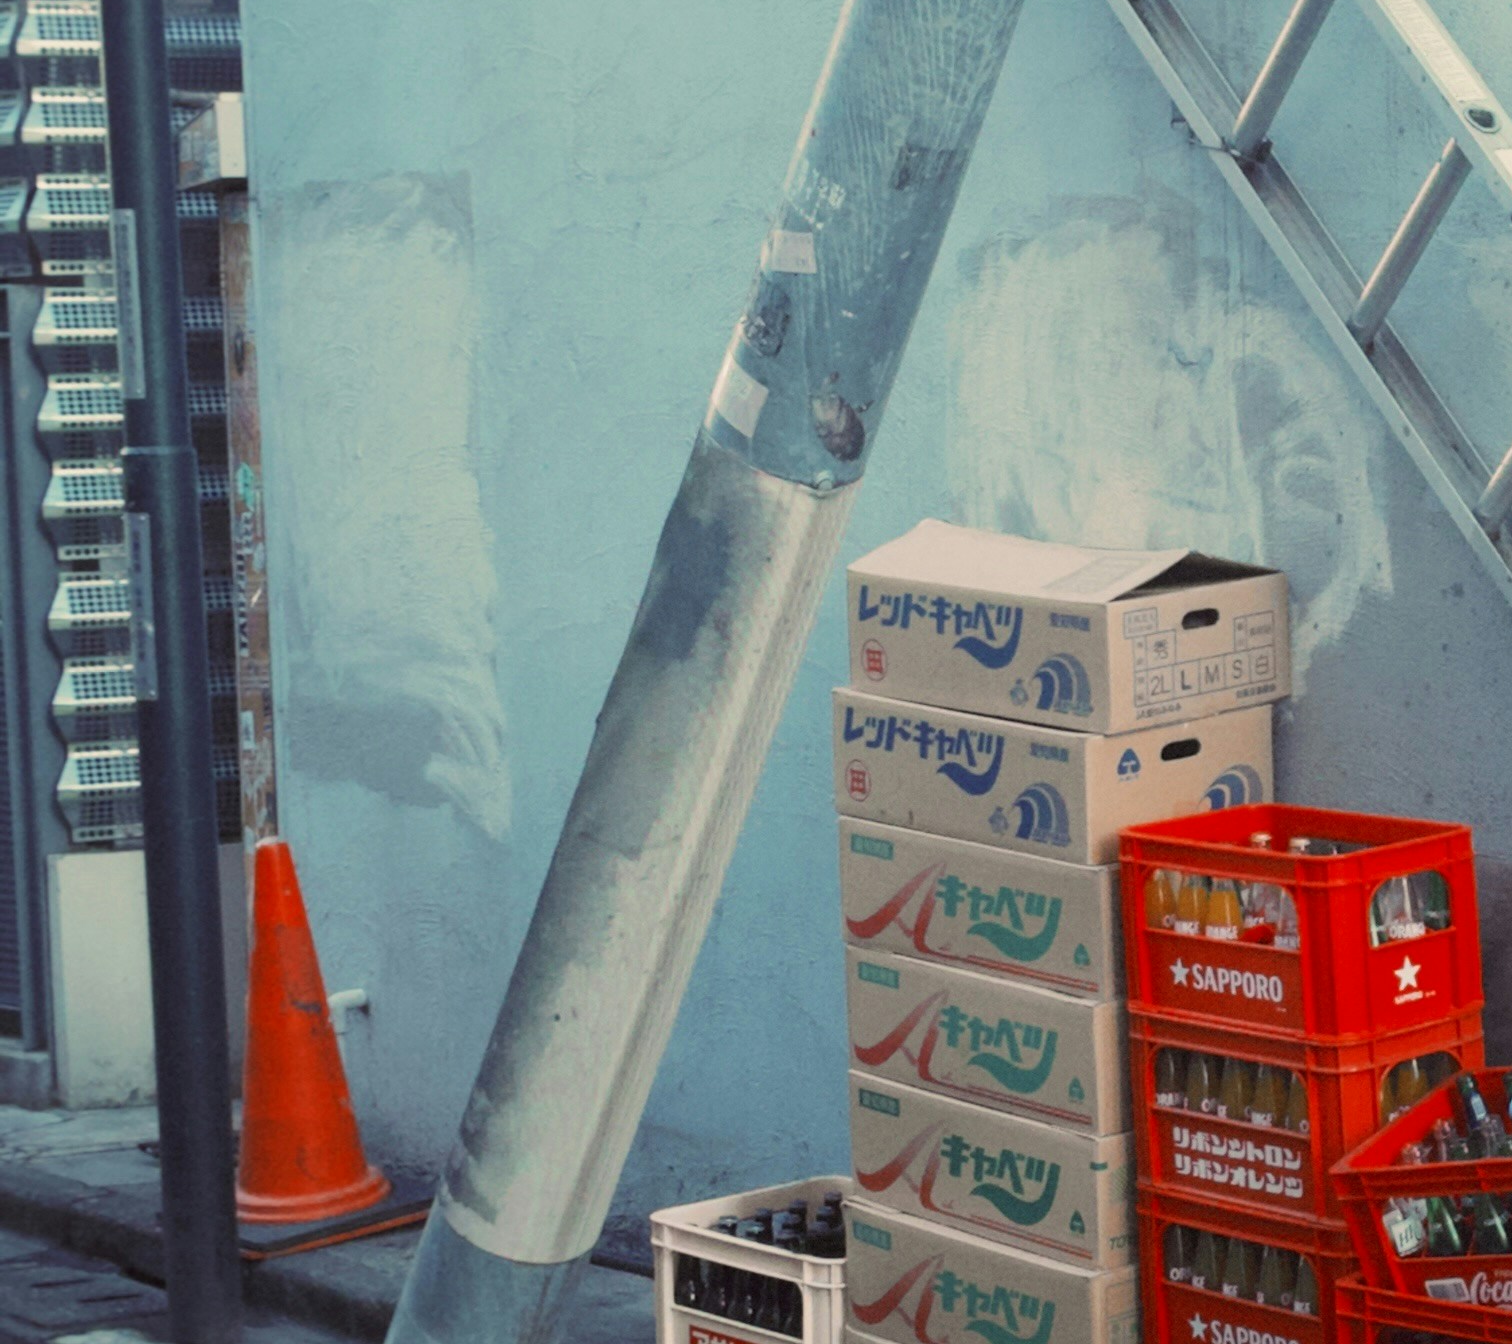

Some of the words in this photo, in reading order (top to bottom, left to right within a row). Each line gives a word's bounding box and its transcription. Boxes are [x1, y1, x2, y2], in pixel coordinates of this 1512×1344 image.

[858, 584, 1024, 670] レッドキャベツ
[1151, 676, 1171, 696] 2L
[1180, 670, 1192, 690] L
[1205, 664, 1220, 685] M
[1232, 659, 1243, 679] S
[843, 706, 1005, 796] レッドキャベツ
[935, 875, 1063, 962] キャベツ
[1192, 964, 1283, 1003] SAPPORO
[939, 1005, 1058, 1095] キャベツ
[940, 1134, 1061, 1226] キャベツ
[1172, 1126, 1301, 1171] リボンシトロン
[1175, 1153, 1303, 1199] リボンオレンジ
